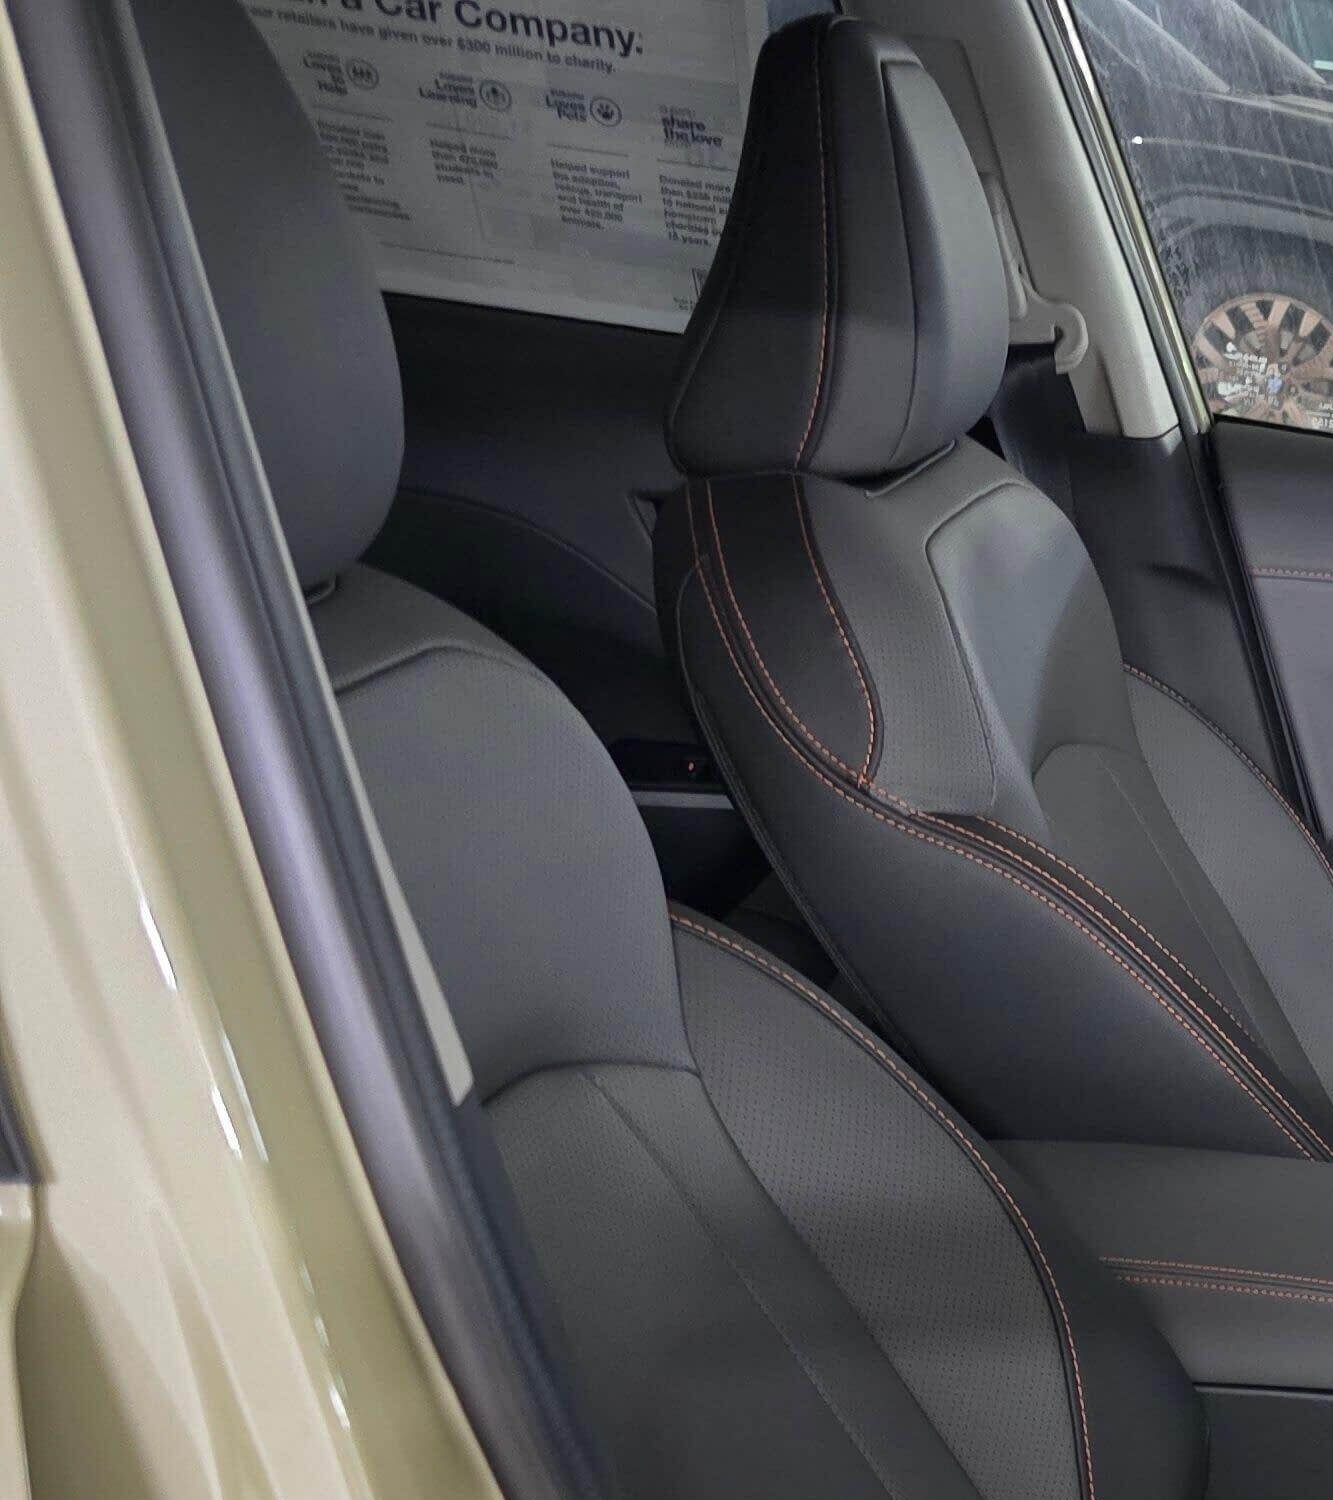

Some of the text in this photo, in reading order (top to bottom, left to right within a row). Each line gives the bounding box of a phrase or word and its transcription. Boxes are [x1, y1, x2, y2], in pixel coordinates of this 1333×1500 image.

[340, 19, 375, 36] have
[378, 27, 419, 42] given
[422, 34, 452, 47] over
[495, 42, 543, 61] million
[547, 51, 562, 64] to
